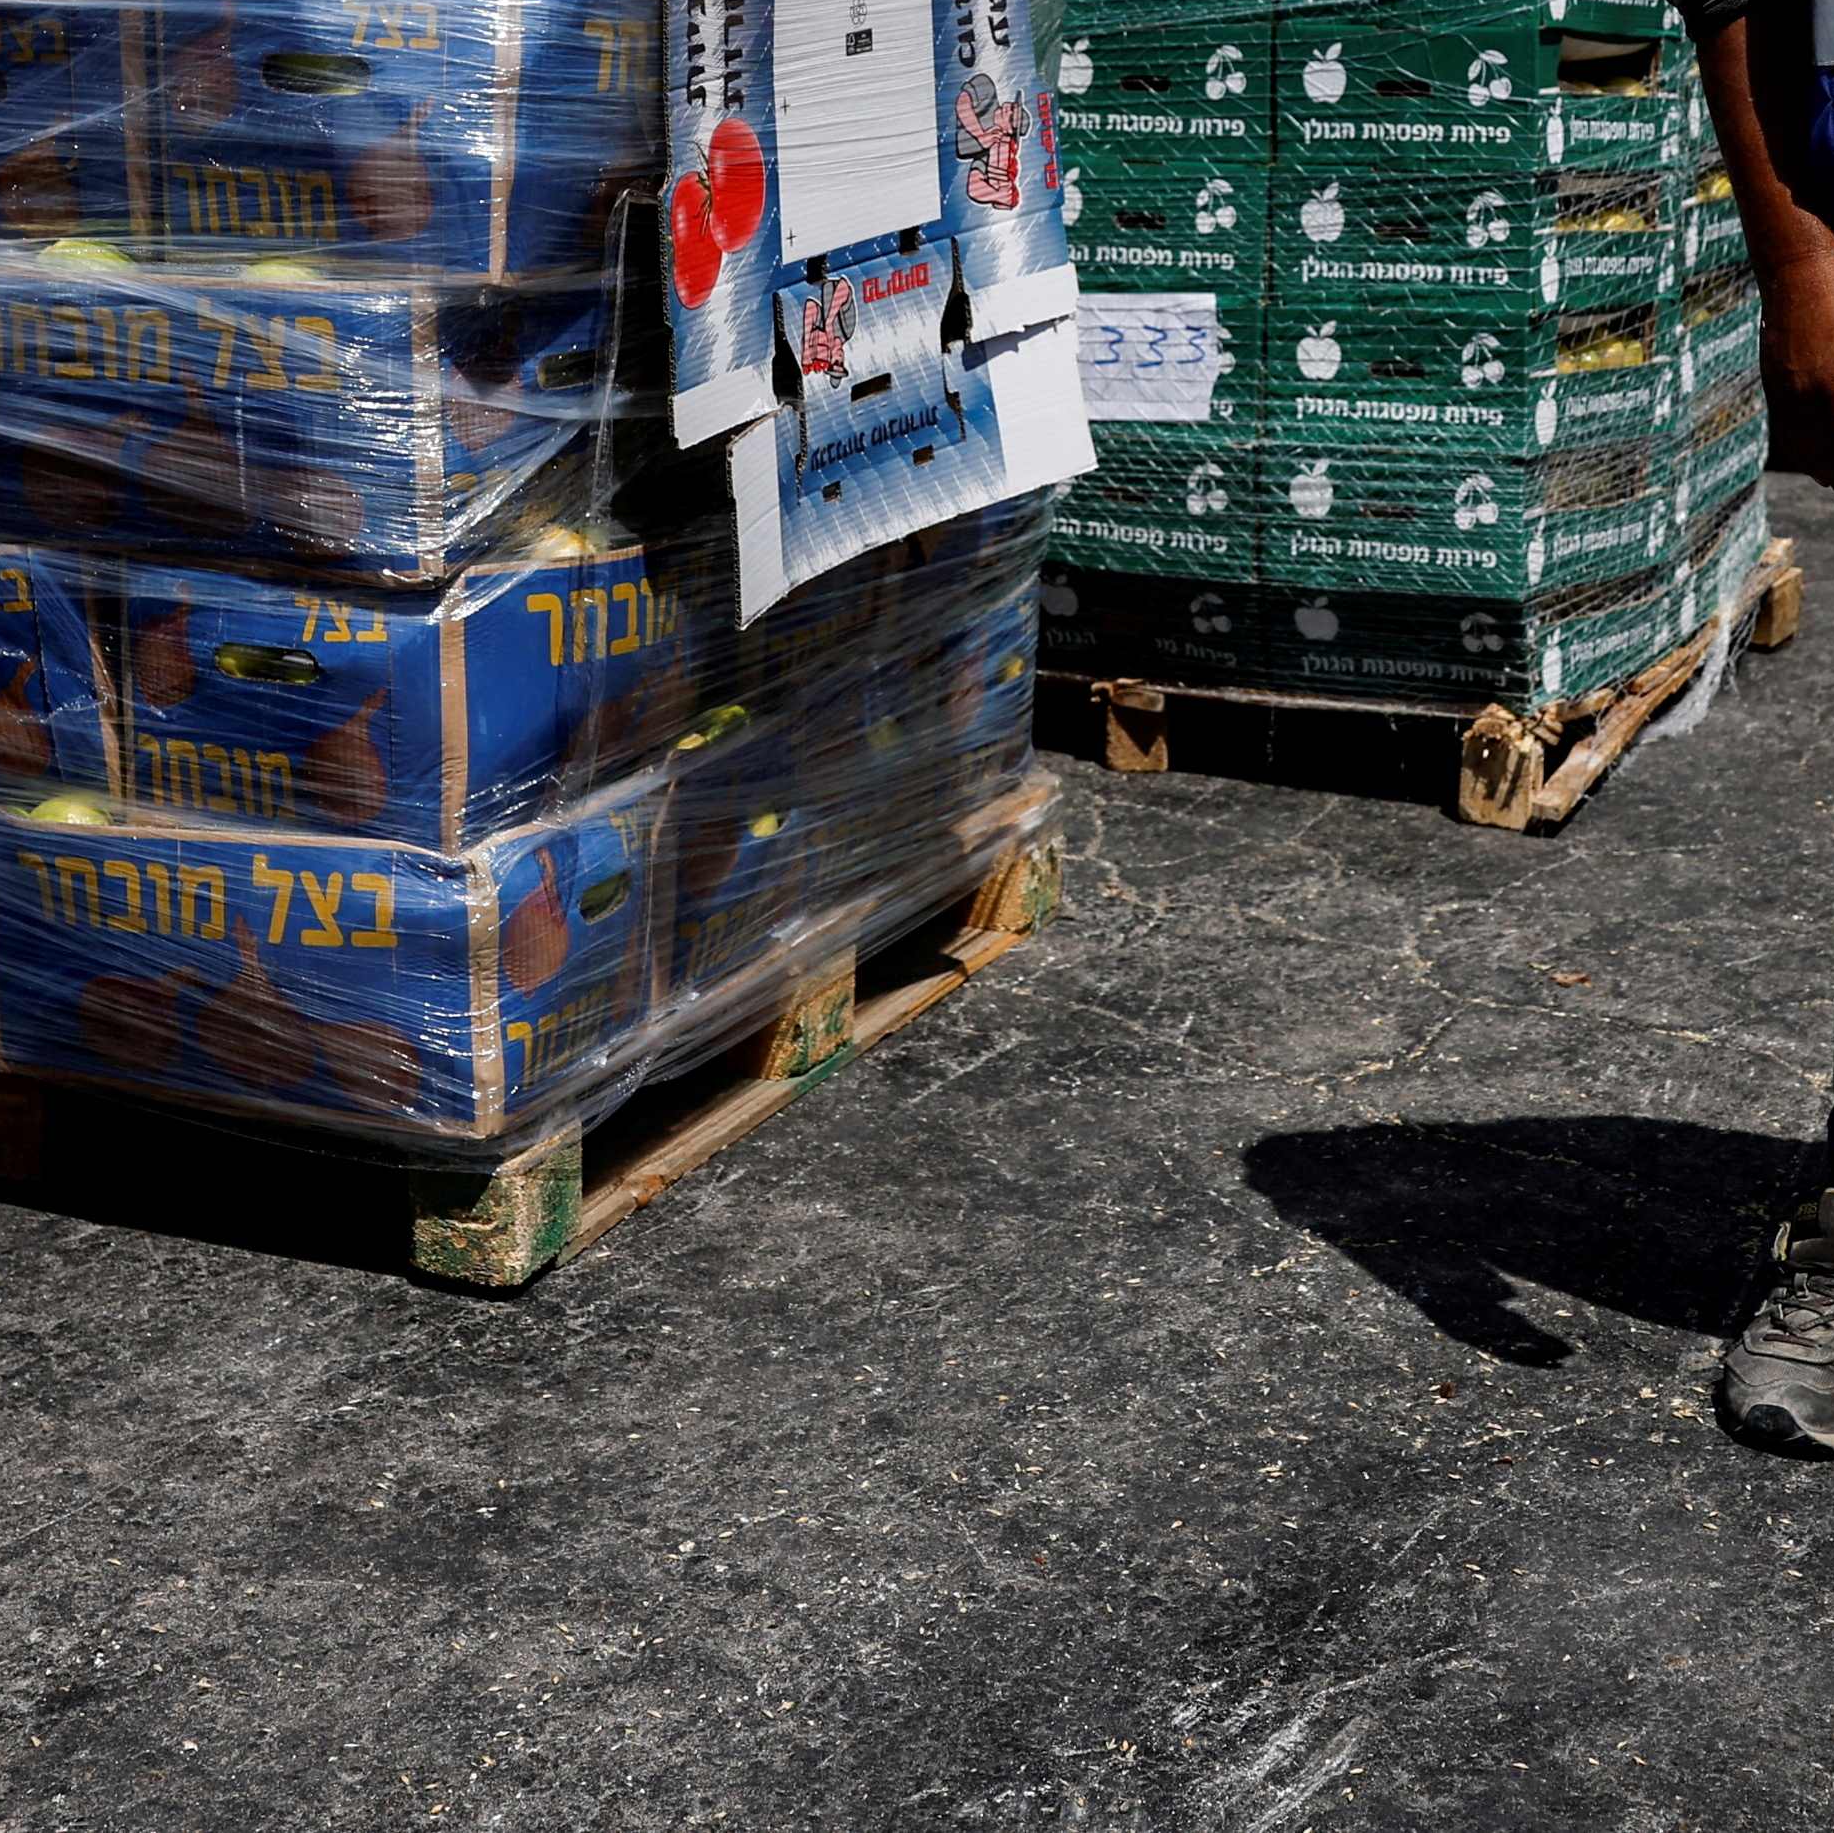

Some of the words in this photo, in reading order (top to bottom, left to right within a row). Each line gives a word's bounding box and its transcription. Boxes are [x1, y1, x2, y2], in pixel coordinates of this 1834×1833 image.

[1105, 114, 1183, 135] מפסגות
[1189, 118, 1246, 137] פירות
[1302, 118, 1356, 145] הגולן
[1360, 121, 1442, 143] מפסגות
[1450, 124, 1511, 145] פירות
[171, 165, 339, 241] מובחר
[197, 298, 345, 392] בצל
[136, 733, 297, 819] מובחר
[16, 850, 227, 941] מובחר
[251, 852, 400, 949] בצל
